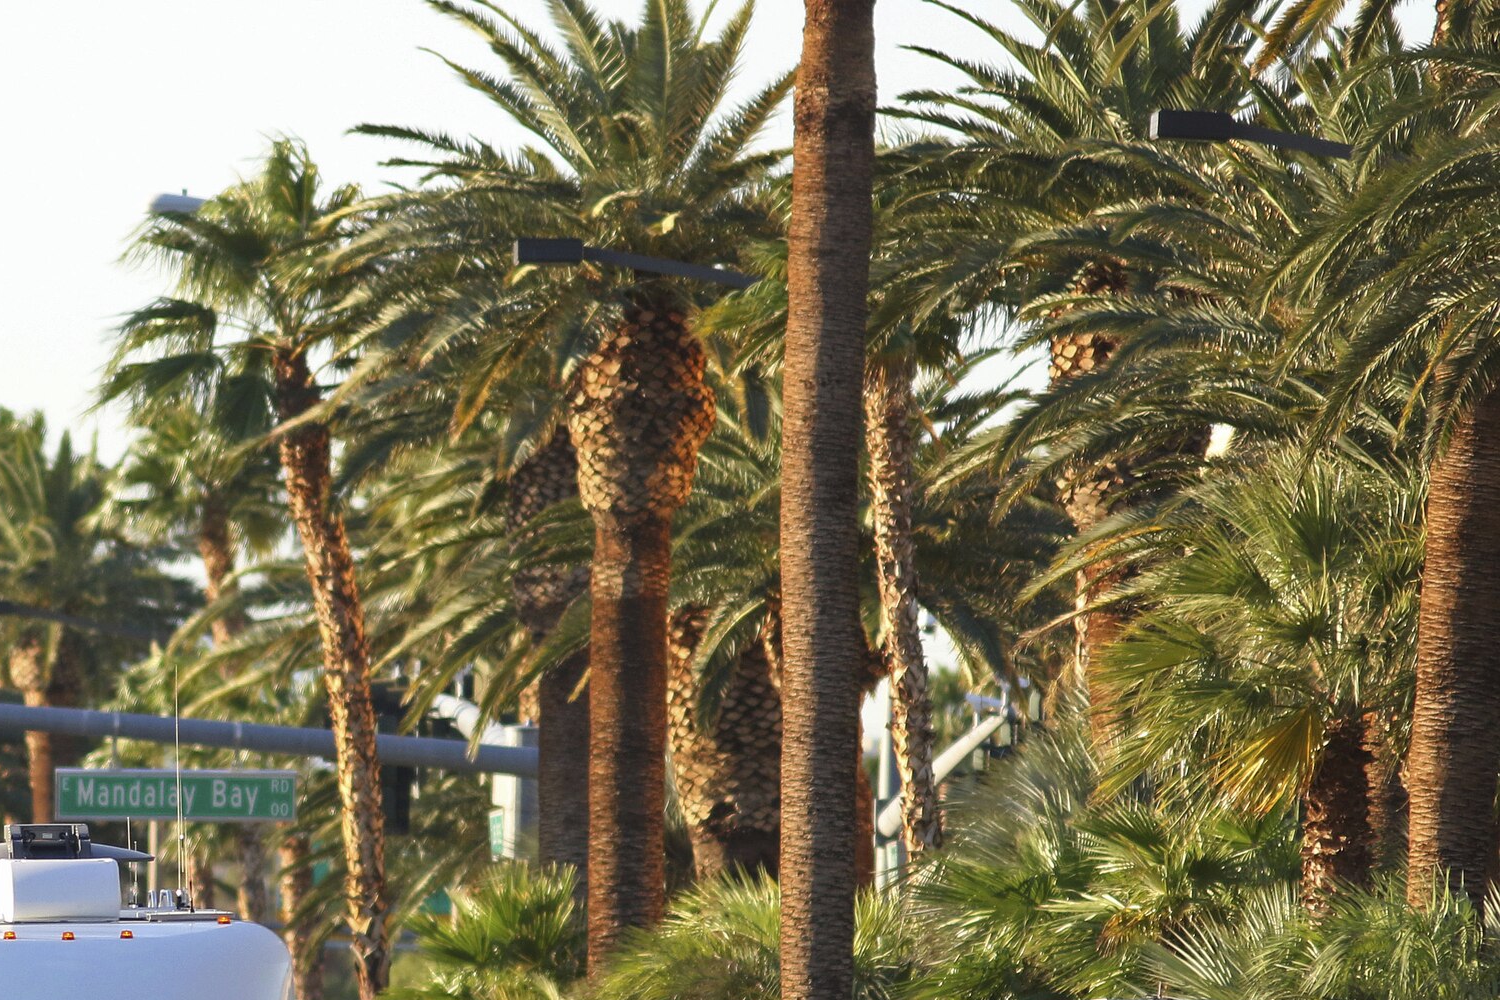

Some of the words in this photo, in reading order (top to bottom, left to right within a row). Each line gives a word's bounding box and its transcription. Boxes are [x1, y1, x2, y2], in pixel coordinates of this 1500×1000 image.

[62, 777, 70, 791] E
[77, 778, 196, 815] Mandalay
[212, 780, 258, 815] Bay
[271, 779, 289, 793] RD
